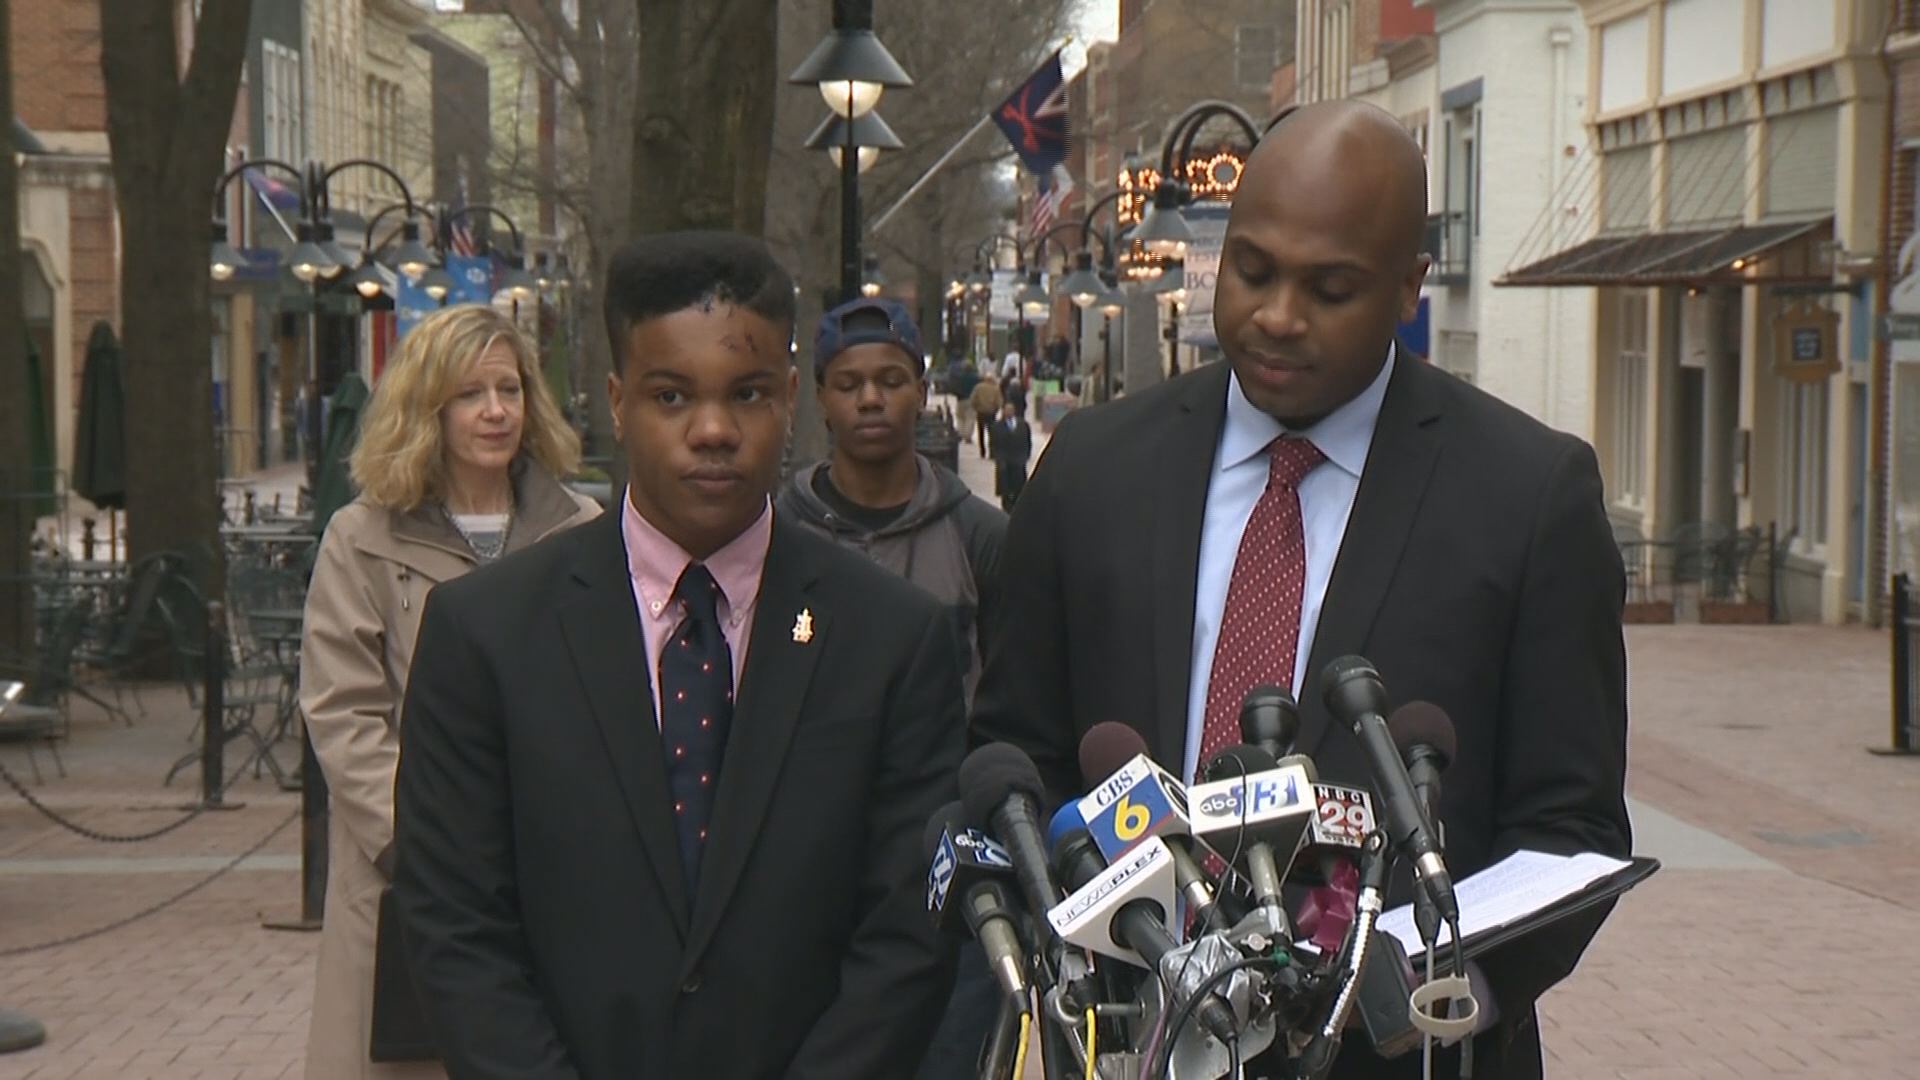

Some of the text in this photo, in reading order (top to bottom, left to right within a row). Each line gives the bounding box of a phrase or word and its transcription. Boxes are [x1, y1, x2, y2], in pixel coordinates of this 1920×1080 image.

[1186, 272, 1217, 289] BO
[1096, 770, 1134, 807] CBS
[1200, 797, 1238, 813] abc
[1115, 794, 1150, 841] 6
[1320, 801, 1372, 836] 29
[1057, 846, 1162, 927] NEWSPLEX
